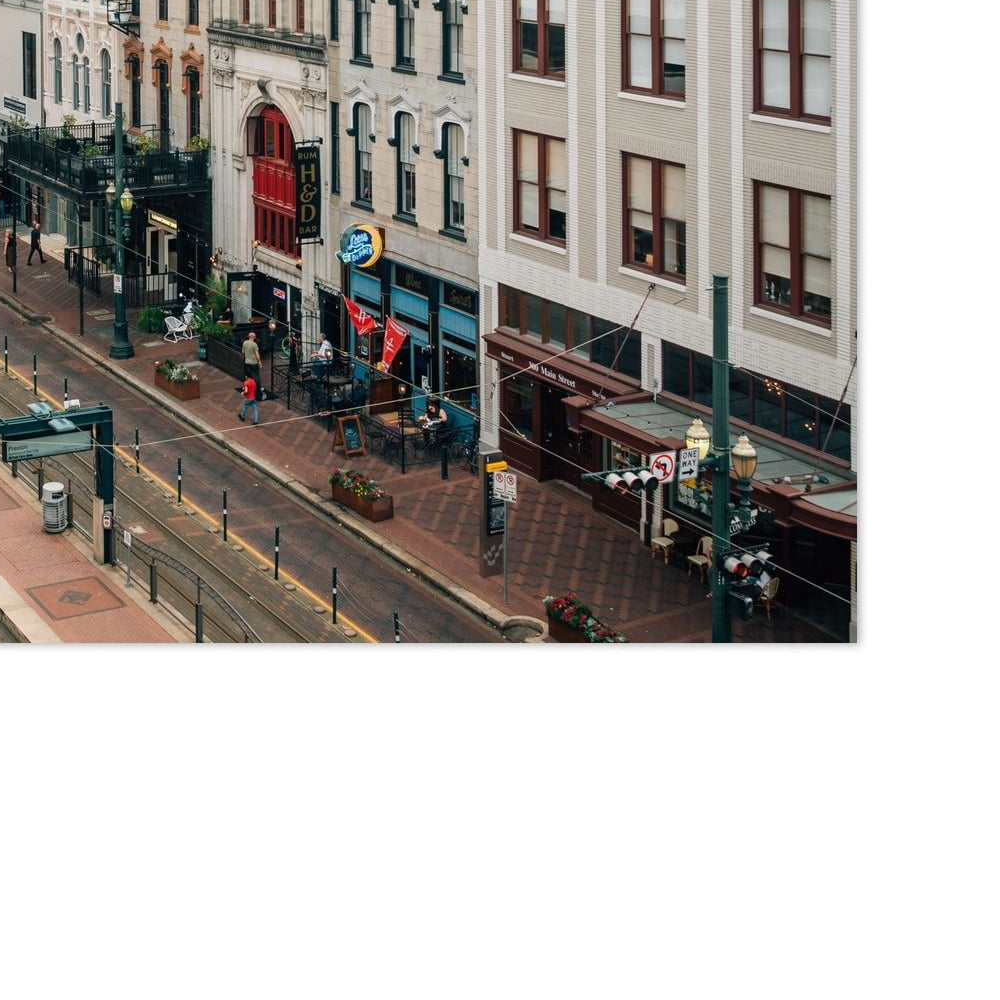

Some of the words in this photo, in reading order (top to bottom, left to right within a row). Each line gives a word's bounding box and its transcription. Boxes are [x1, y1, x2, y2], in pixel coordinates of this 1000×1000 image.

[297, 151, 318, 160] RUM
[299, 225, 318, 234] BAR
[540, 366, 557, 380] Main
[557, 371, 577, 389] Street
[682, 450, 697, 460] ONE
[682, 459, 697, 468] WAY
